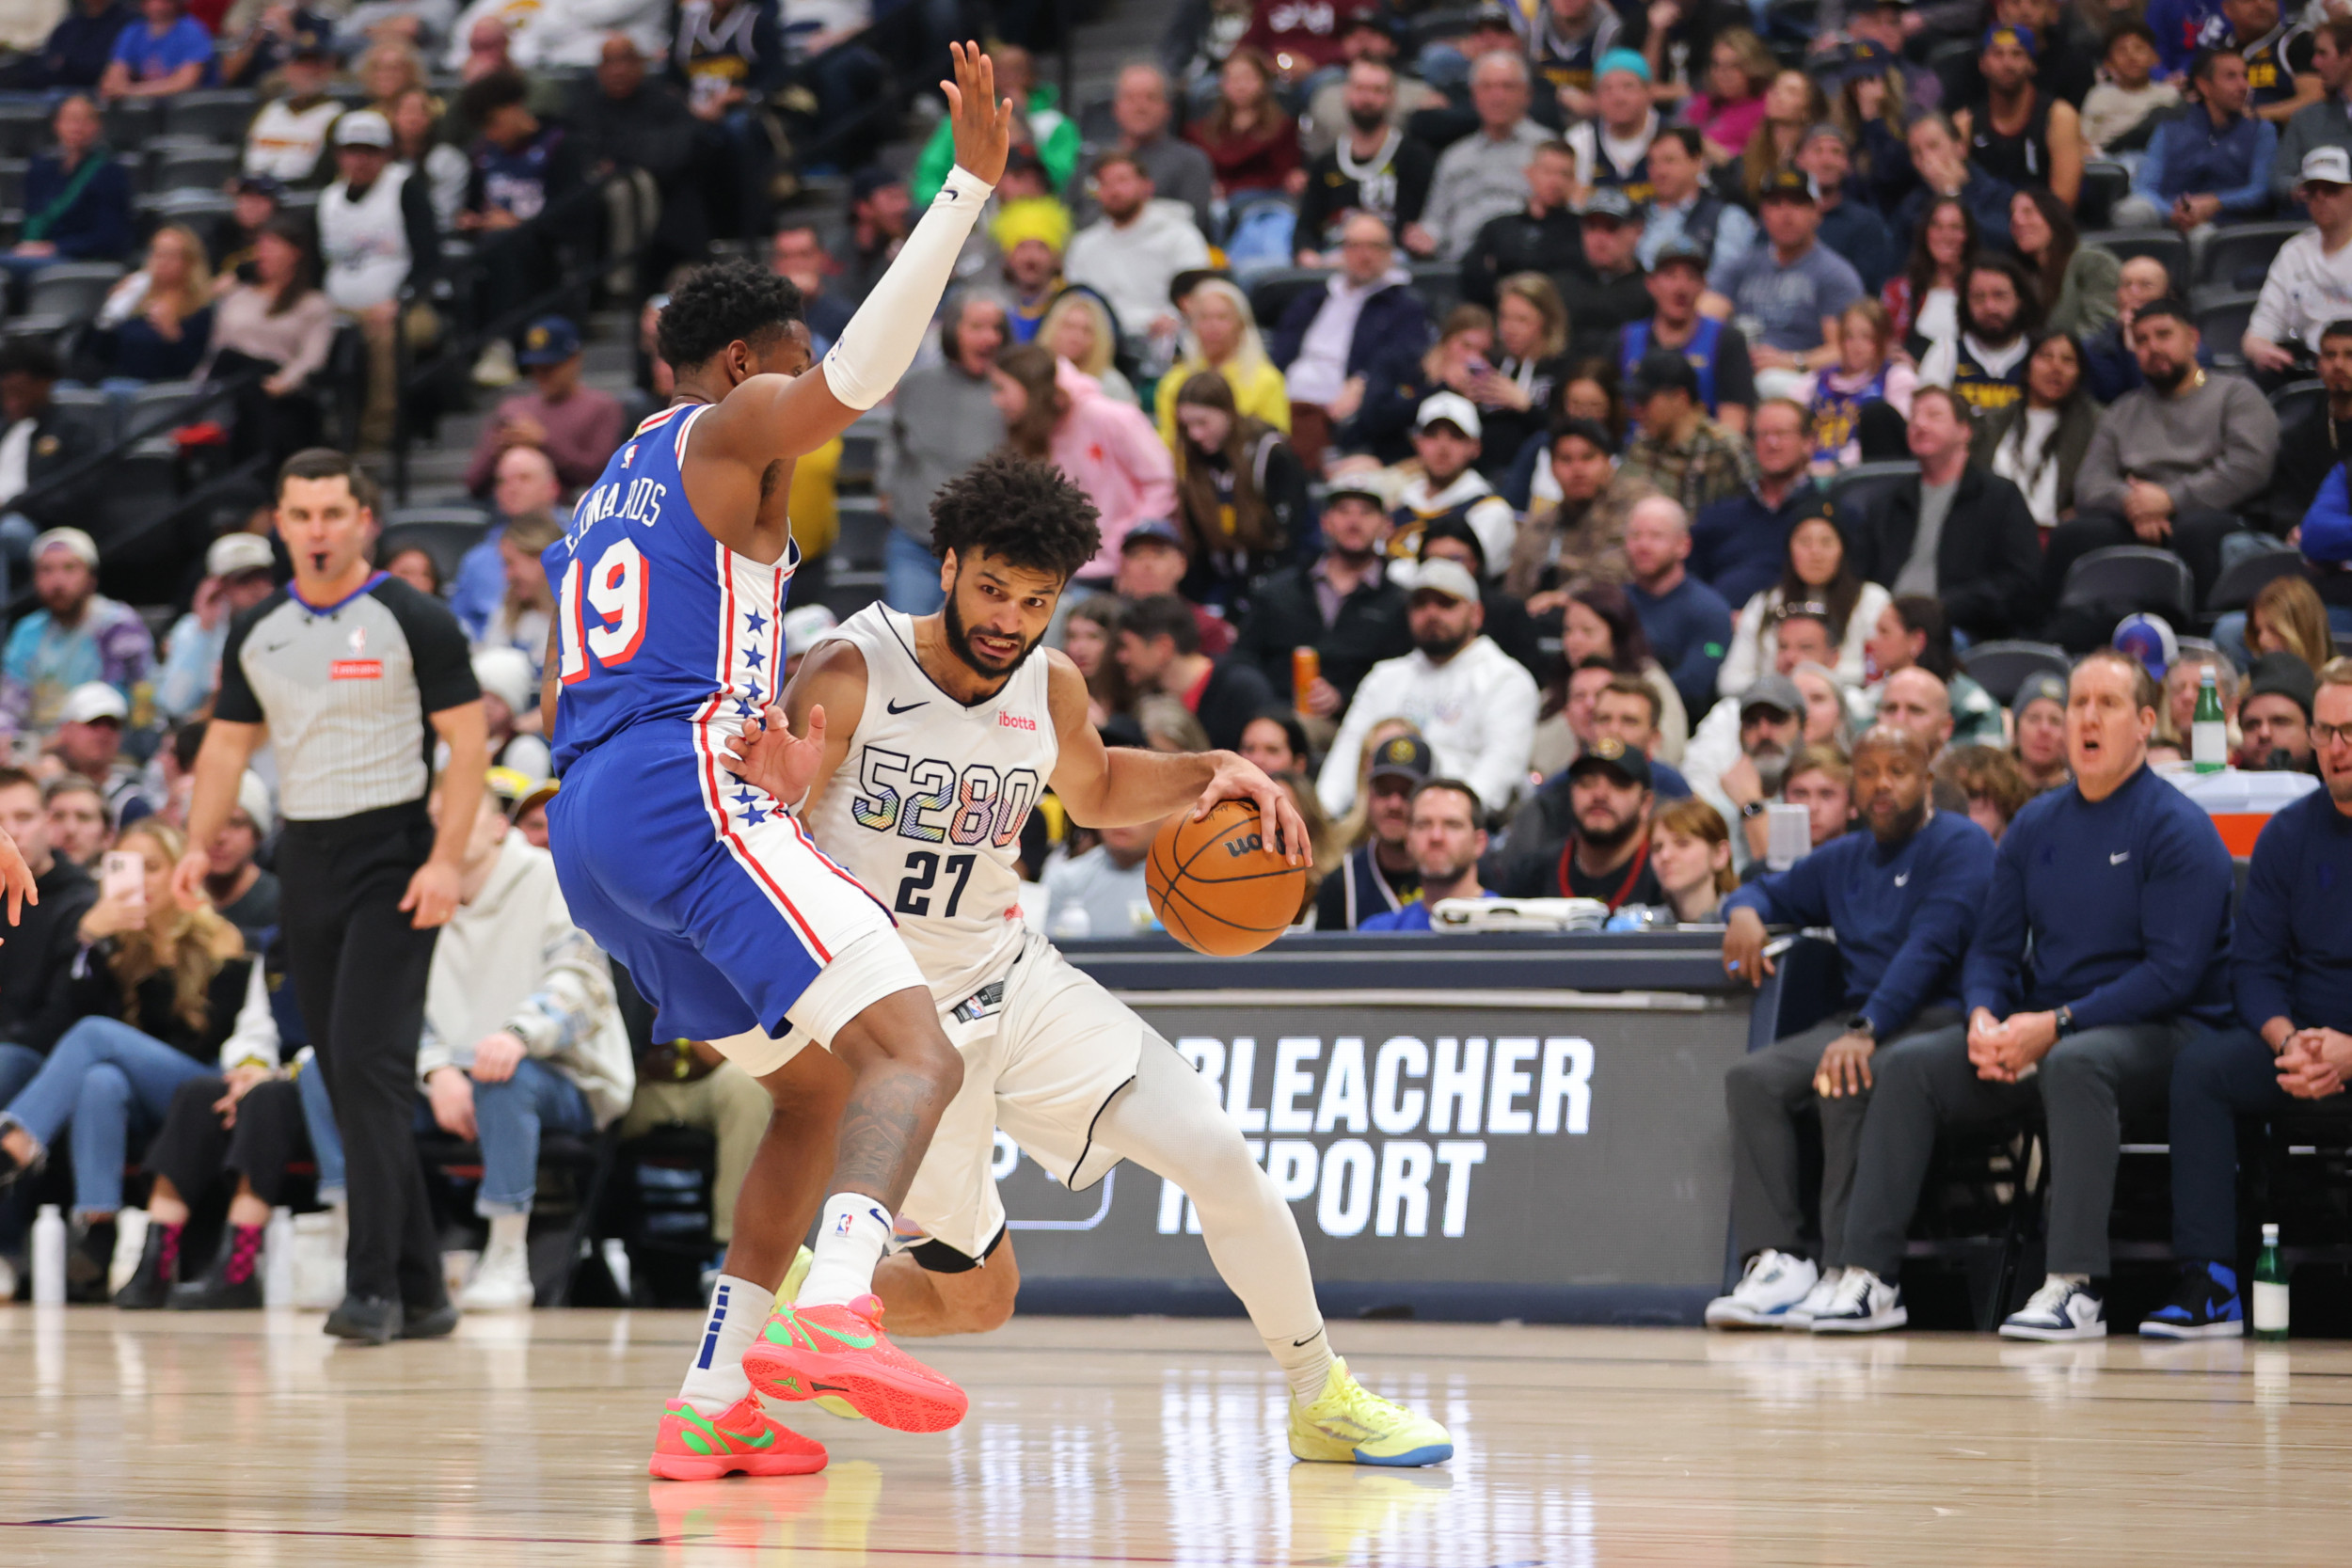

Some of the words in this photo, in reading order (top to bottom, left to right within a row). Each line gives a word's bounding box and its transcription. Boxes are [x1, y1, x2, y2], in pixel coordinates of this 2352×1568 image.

[560, 537, 649, 686] 19
[998, 711, 1037, 731] ibotta
[851, 744, 1039, 848] 5280
[894, 850, 977, 918] 27
[1157, 1138, 1487, 1238] PORT
